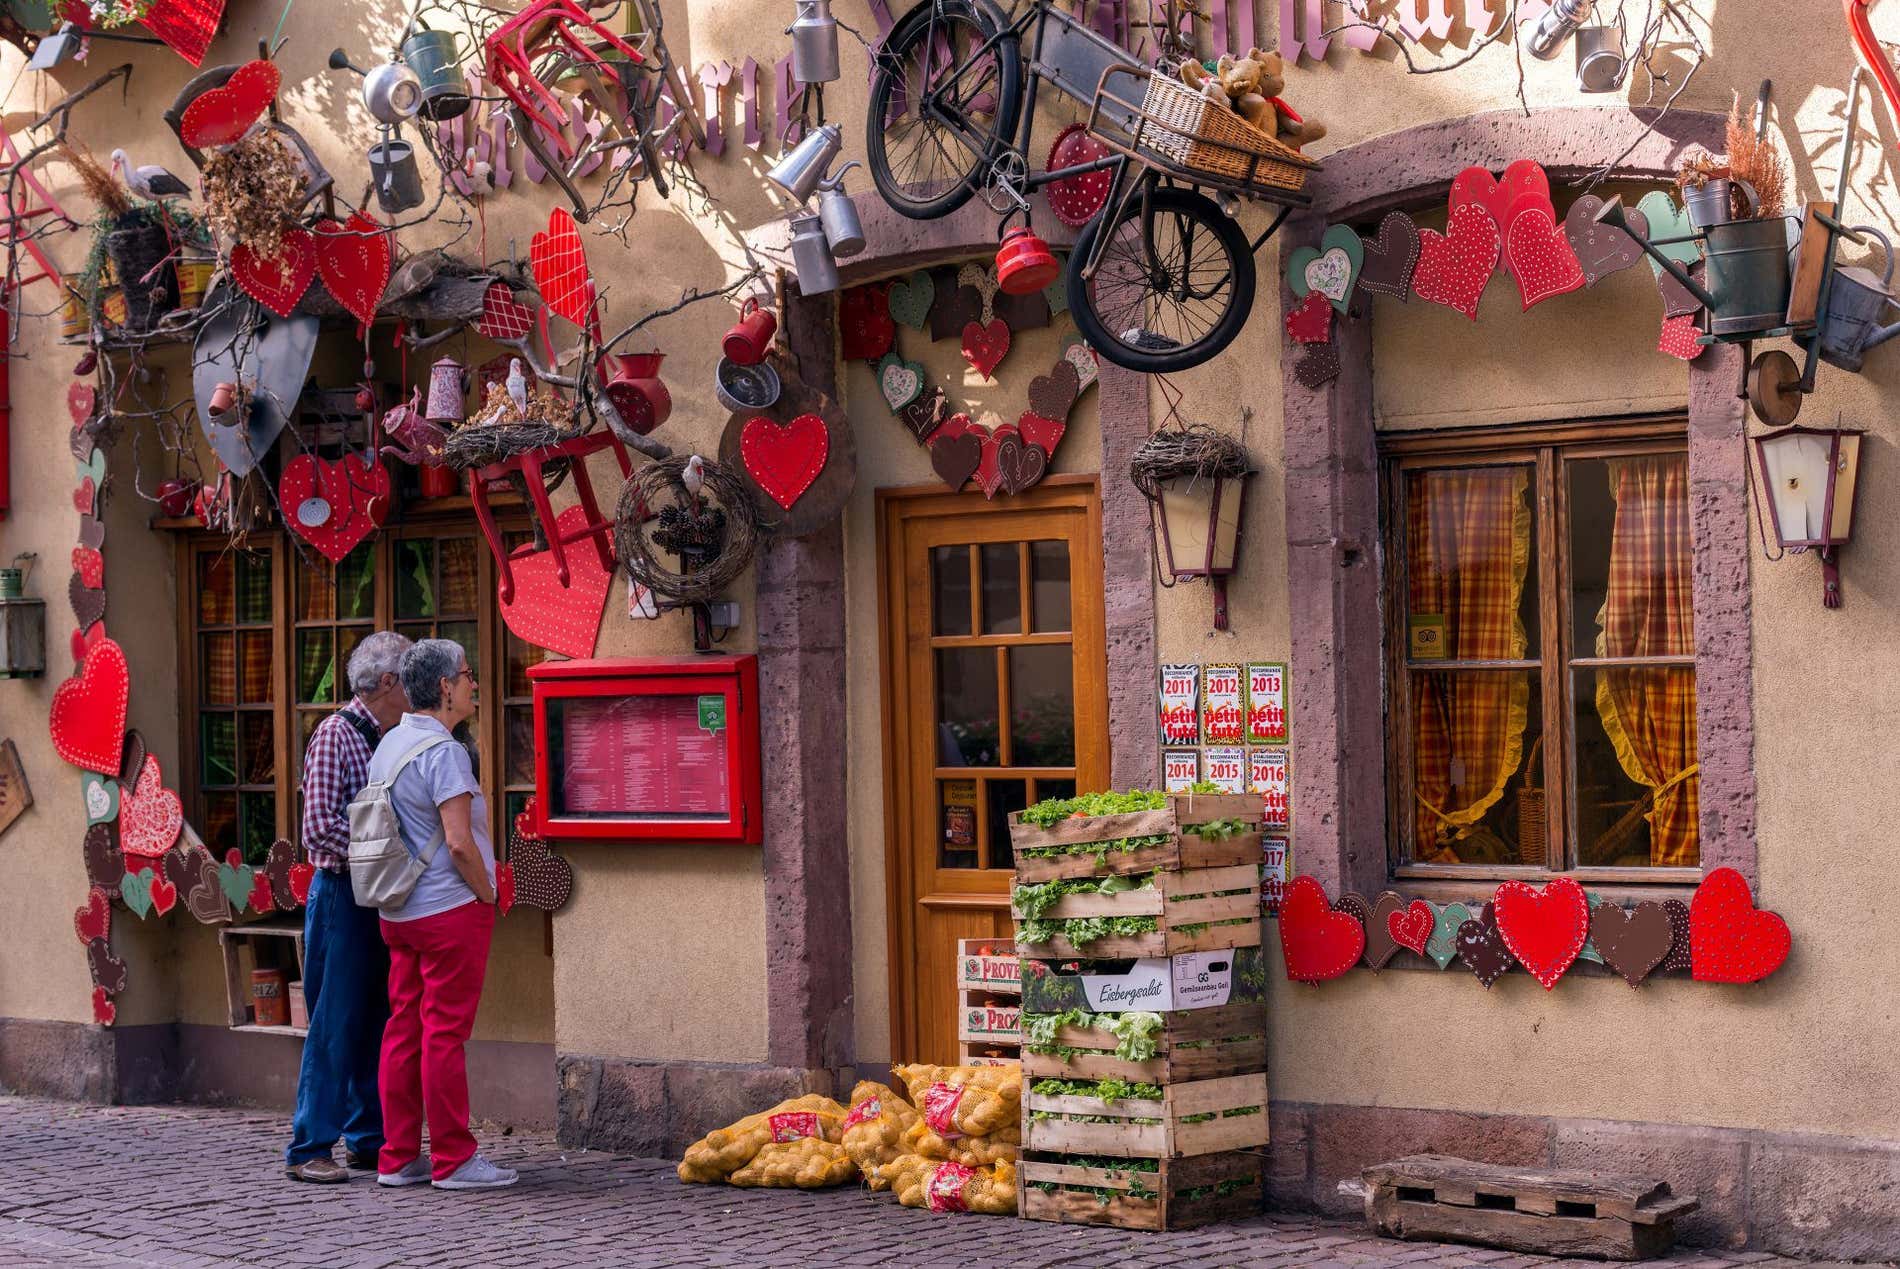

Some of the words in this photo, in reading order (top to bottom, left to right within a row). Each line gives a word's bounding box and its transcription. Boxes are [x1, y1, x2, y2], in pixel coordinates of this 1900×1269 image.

[1165, 679, 1192, 694] 2011
[1209, 678, 1237, 693] 2012
[1252, 677, 1281, 692] 2013
[1160, 708, 1197, 728] petit
[1204, 707, 1242, 728] petit
[1247, 706, 1286, 727] petit
[1167, 724, 1198, 738] futé
[1211, 723, 1242, 738] futé
[1254, 722, 1286, 738] futé
[1167, 763, 1195, 778] 2014
[1210, 763, 1239, 778] 2015
[1253, 765, 1284, 781] 2016
[1263, 792, 1288, 808] etit
[1262, 808, 1289, 823] uté
[1263, 851, 1284, 866] 017
[1198, 972, 1209, 983] GG
[1099, 978, 1163, 1006] Eisbergsalat
